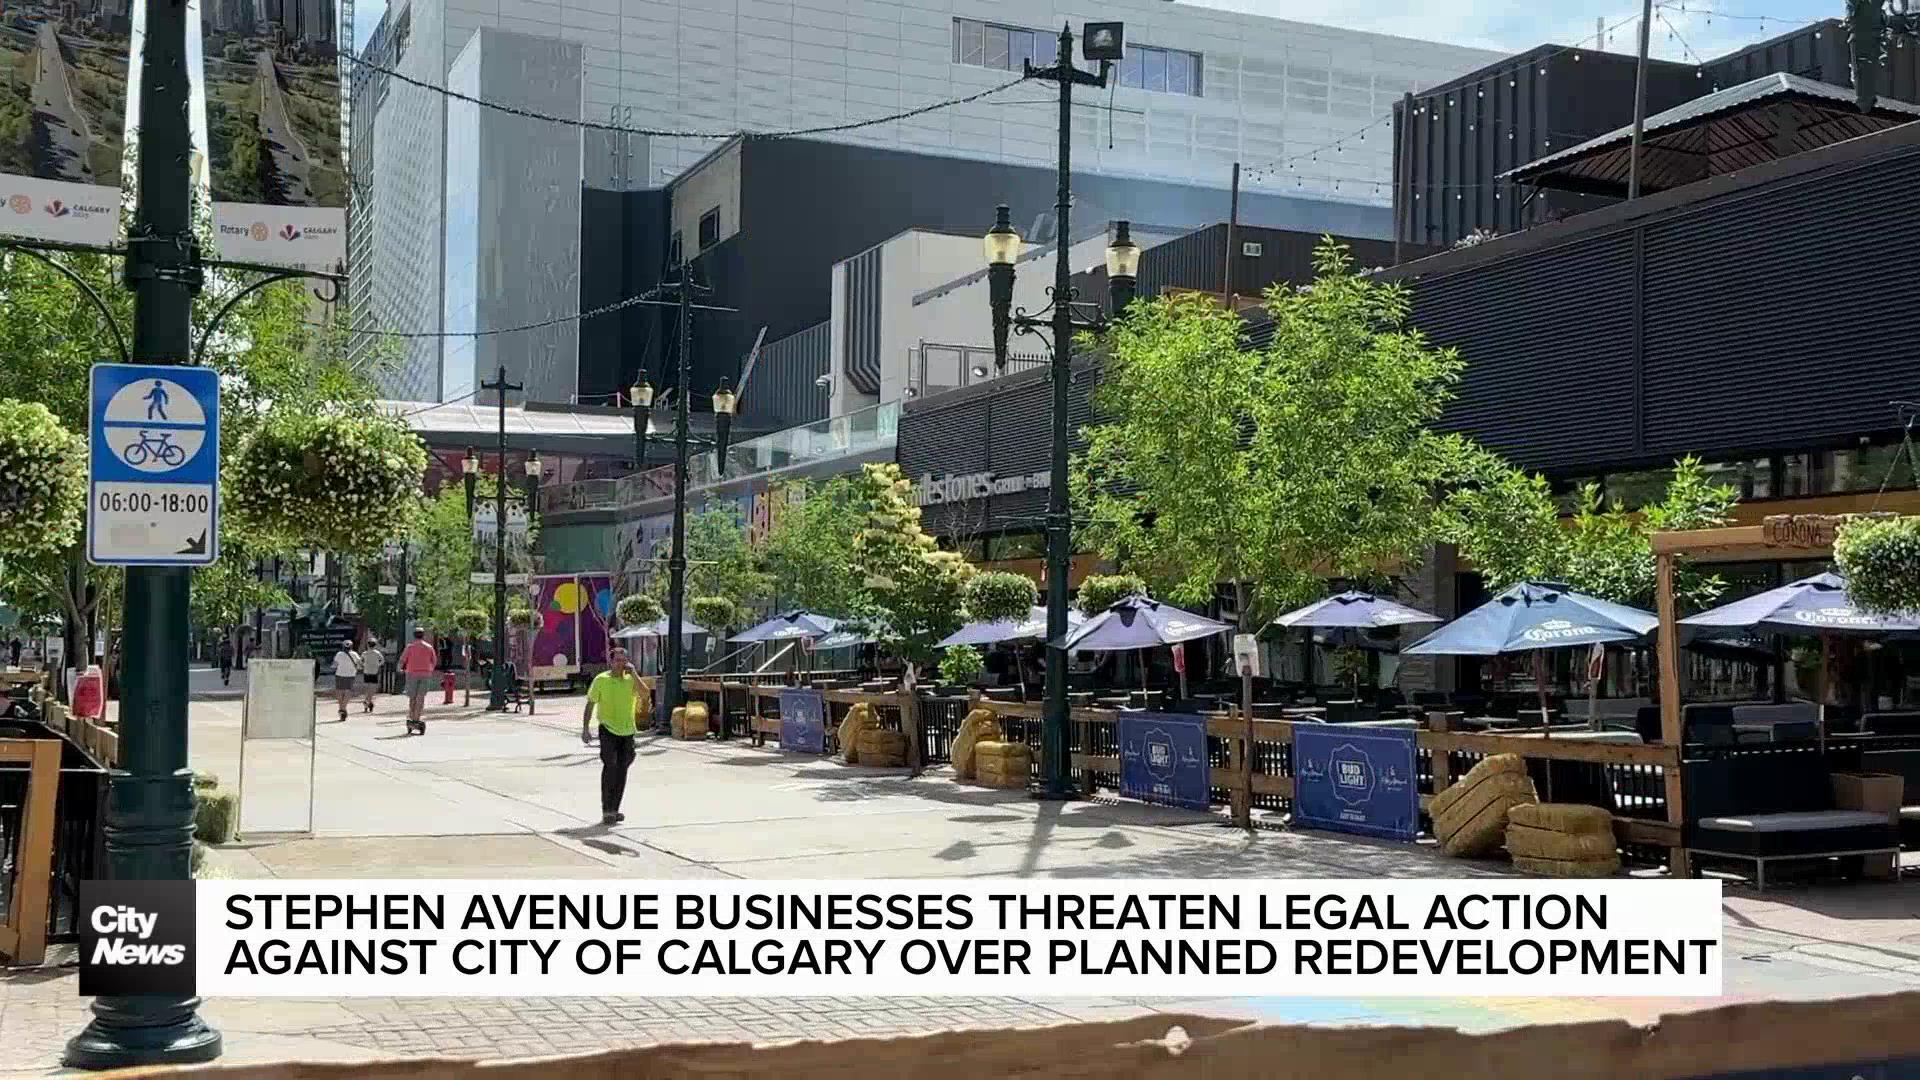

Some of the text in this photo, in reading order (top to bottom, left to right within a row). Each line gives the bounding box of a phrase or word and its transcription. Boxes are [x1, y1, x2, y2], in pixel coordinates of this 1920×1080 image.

[220, 224, 249, 237] Rotary
[100, 492, 208, 513] 06:00-18:00
[1773, 519, 1823, 544] CORONA
[1523, 626, 1596, 641] Corona
[1341, 763, 1361, 775] BUD
[1340, 773, 1365, 786] LIGHT
